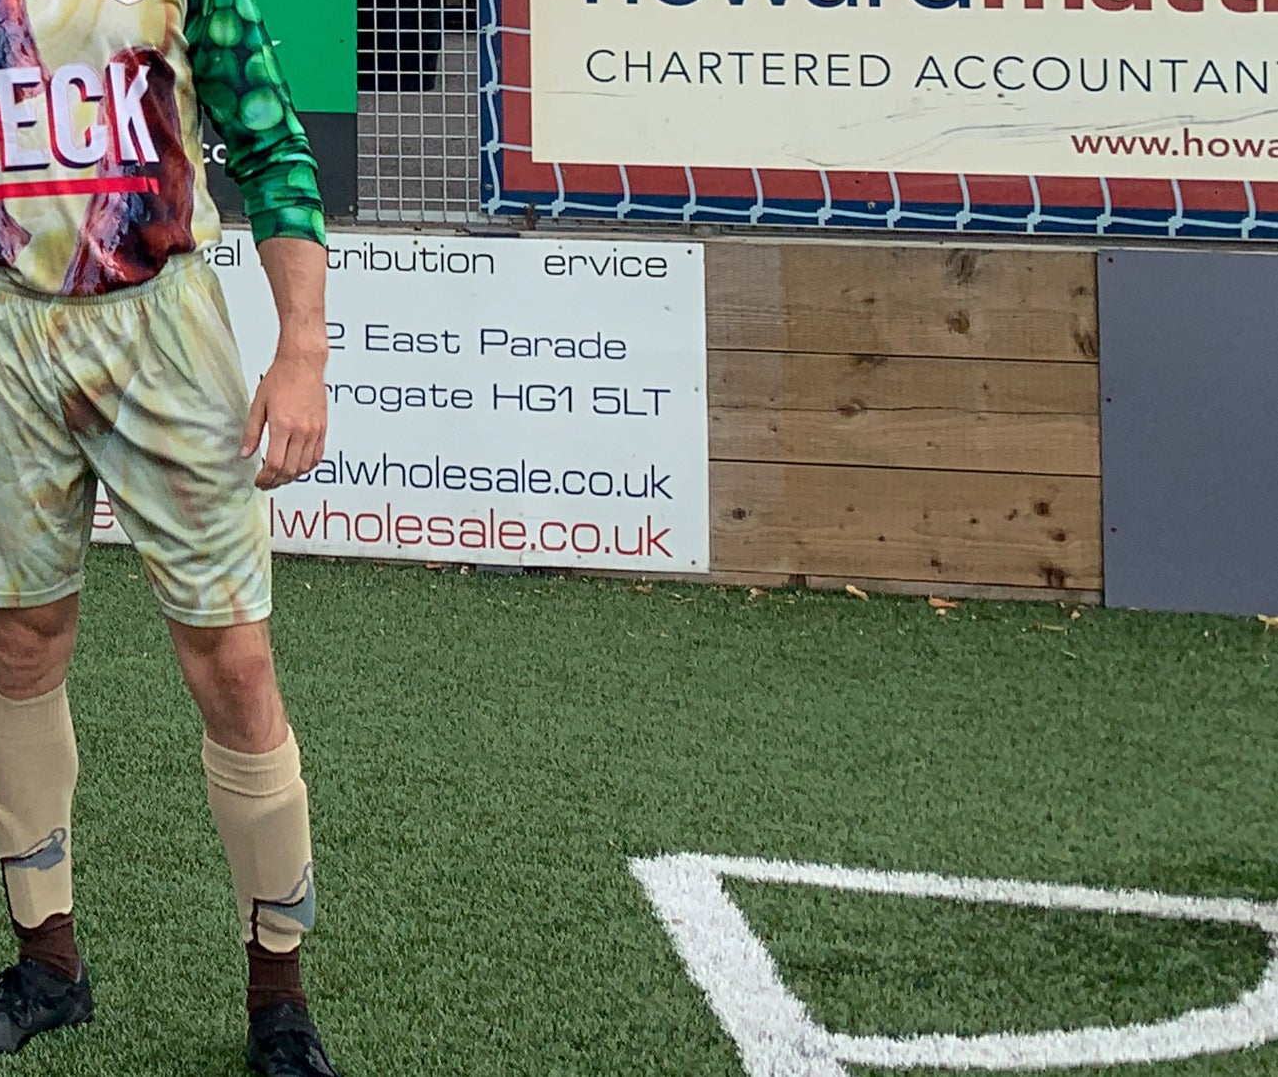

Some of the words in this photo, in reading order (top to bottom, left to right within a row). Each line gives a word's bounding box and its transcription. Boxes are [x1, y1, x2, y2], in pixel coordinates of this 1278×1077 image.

[586, 49, 892, 88] CHARTERED
[915, 55, 1278, 95] ACCOUNTAN
[365, 322, 461, 355] East
[480, 327, 628, 361] Parade
[492, 384, 575, 413] HG1
[593, 387, 671, 417] 5LT
